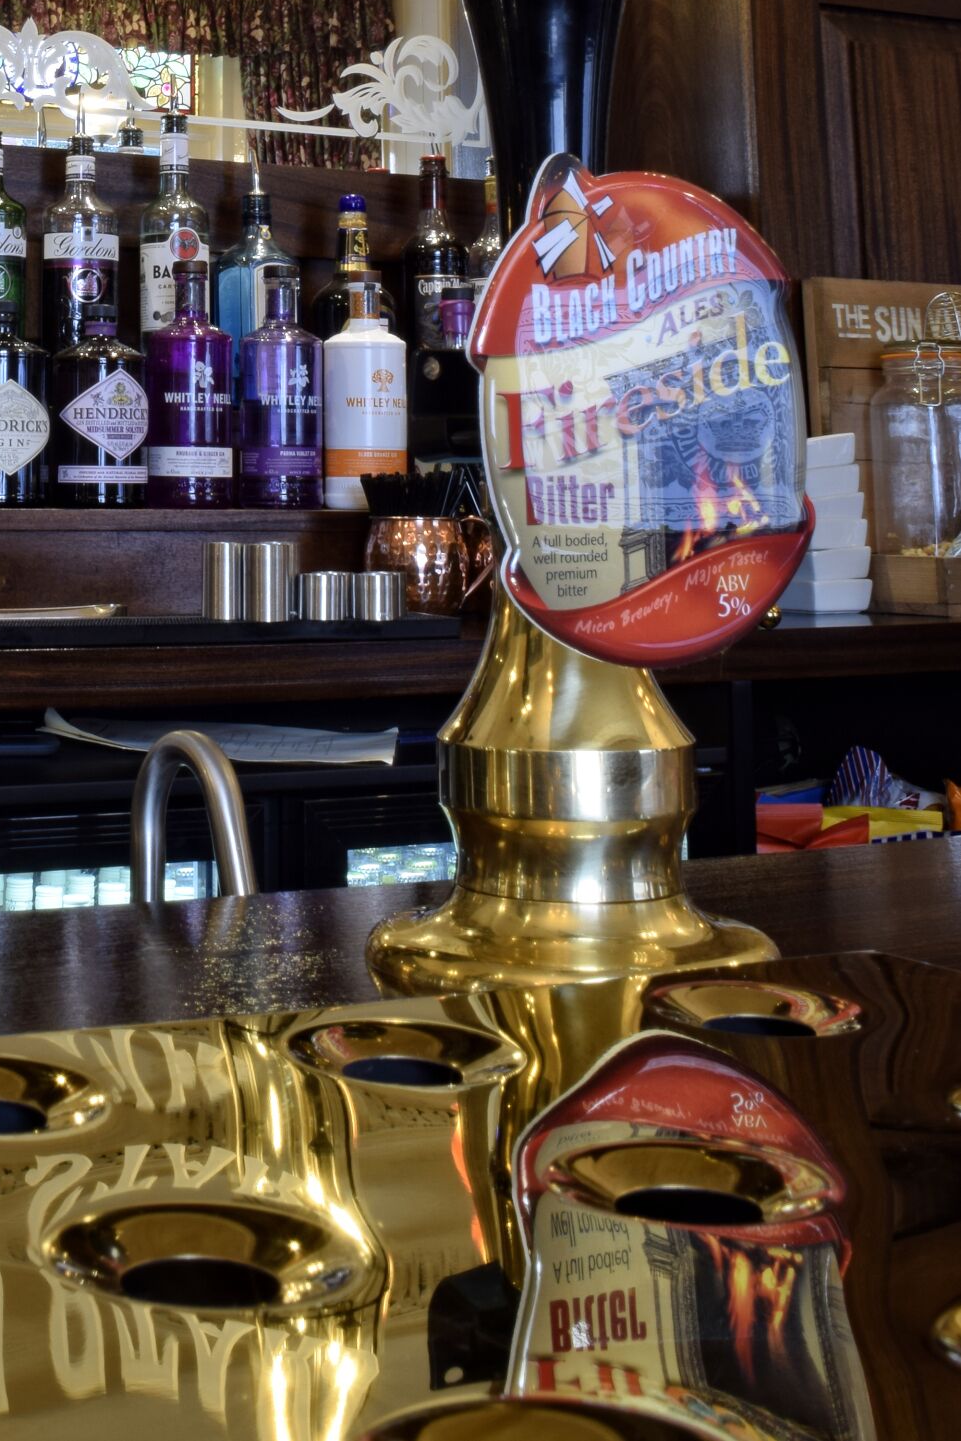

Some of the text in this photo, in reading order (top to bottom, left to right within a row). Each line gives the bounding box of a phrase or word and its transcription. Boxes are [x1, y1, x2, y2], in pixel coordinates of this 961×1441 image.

[53, 235, 117, 259] Gordon's
[531, 228, 738, 344] BLACK COUNTRY
[656, 292, 725, 348] ALES
[831, 303, 872, 330] THE
[874, 305, 923, 343] SUN
[164, 392, 211, 404] WHITLEY
[346, 397, 390, 408] WHILEY
[526, 474, 615, 526] Bitter
[532, 533, 608, 549] A full bodied,
[533, 549, 609, 565] well rounded
[545, 569, 598, 584] premium
[715, 574, 751, 592] ABV
[557, 584, 588, 598] bitter
[574, 619, 615, 635] Micro
[620, 591, 679, 627] Brewery,
[684, 562, 724, 592] Major
[717, 593, 752, 618] 5%
